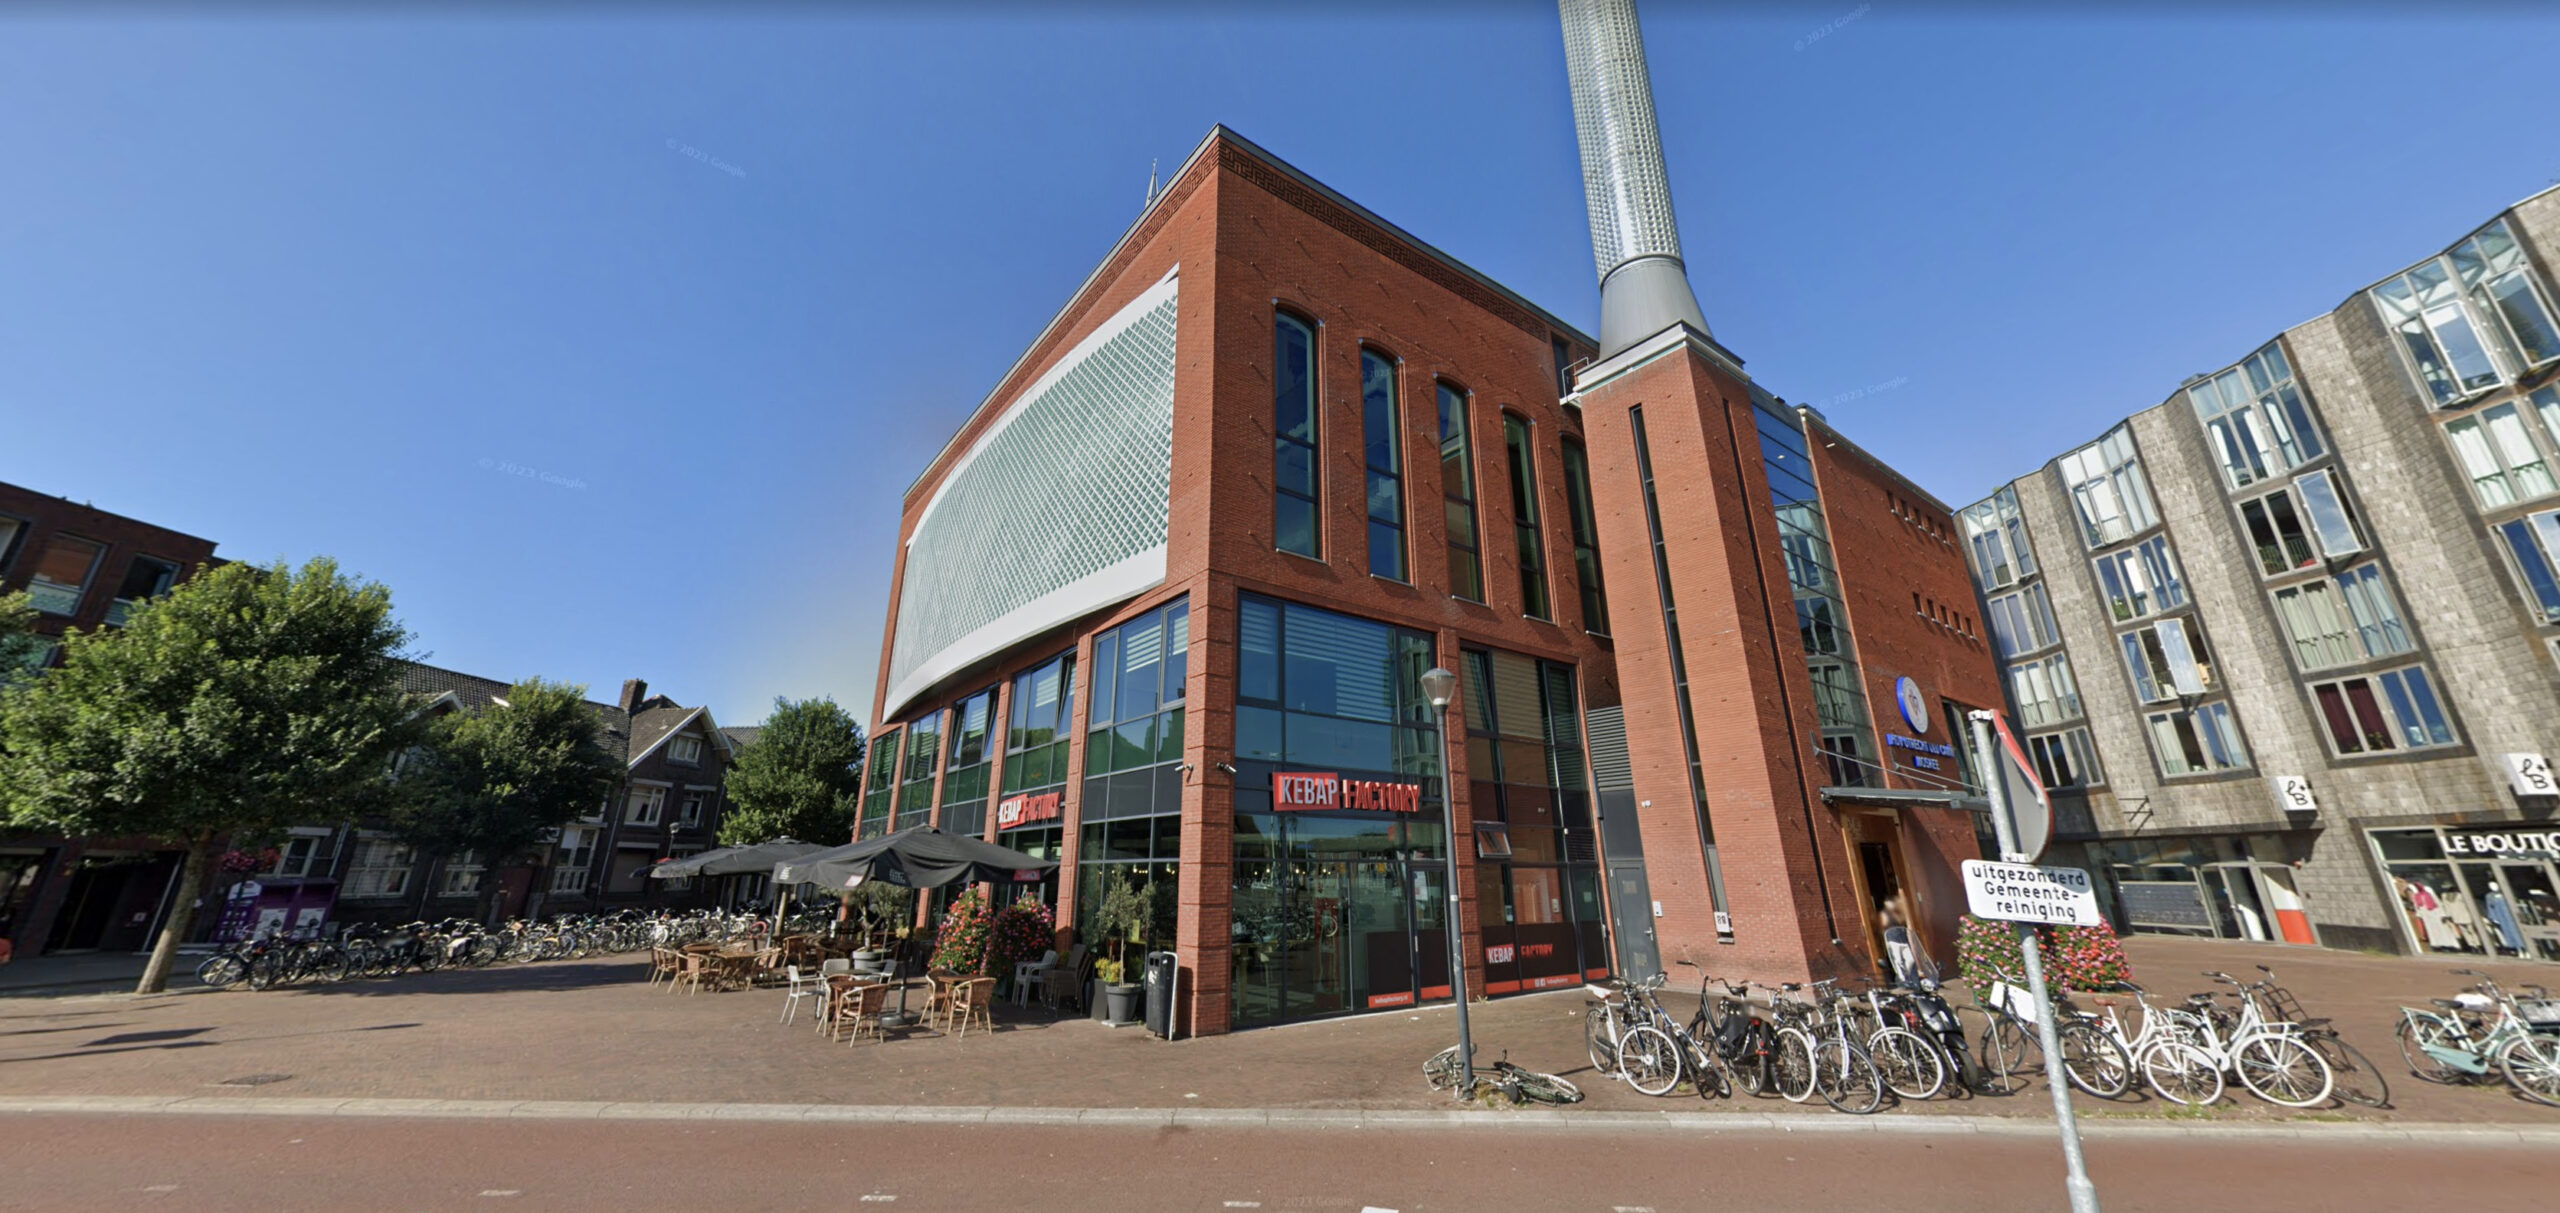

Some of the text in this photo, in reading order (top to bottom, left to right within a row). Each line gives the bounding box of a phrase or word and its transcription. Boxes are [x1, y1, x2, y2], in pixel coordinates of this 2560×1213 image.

[1281, 775, 1421, 812] KEBAP FACTORY
[998, 799, 1023, 824] KEBAP
[2440, 835, 2470, 853] LE
[1972, 865, 2085, 886] uitgezonderd
[1984, 881, 2080, 901] Gemeente-
[1996, 900, 2077, 923] reiniging
[1488, 944, 1553, 964] KEBAP FACTORY
